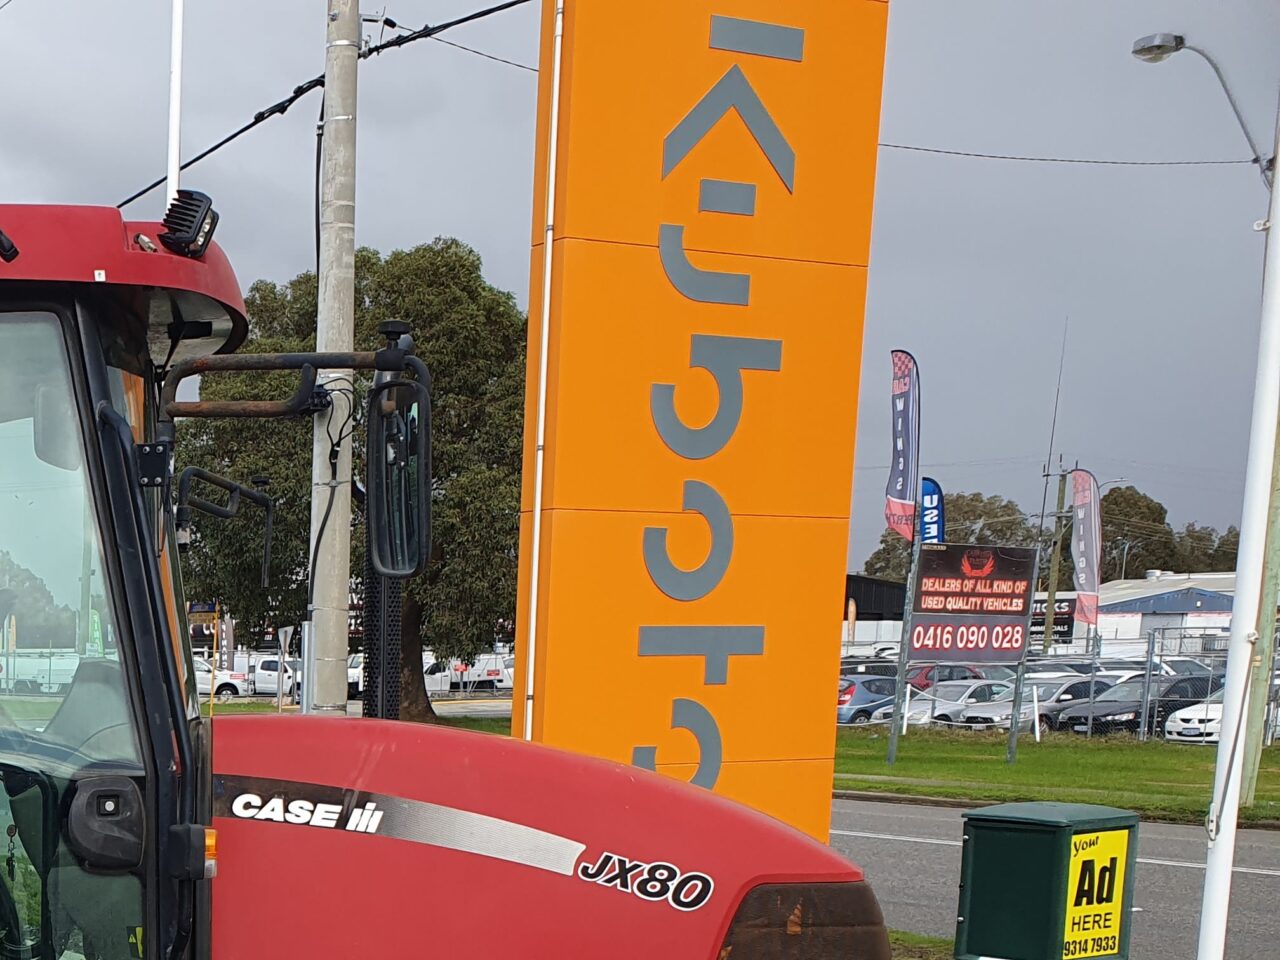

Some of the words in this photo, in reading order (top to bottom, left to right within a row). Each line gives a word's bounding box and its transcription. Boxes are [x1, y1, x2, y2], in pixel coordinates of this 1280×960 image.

[921, 577, 962, 592] DEALERS
[963, 579, 976, 593] OF
[975, 579, 992, 593] ALL
[993, 580, 1013, 594] KIND
[1014, 581, 1028, 594] OF
[921, 596, 945, 609] USED
[946, 597, 982, 611] QUALITY
[983, 598, 1024, 611] VEHICLES
[913, 625, 953, 649] 0416
[956, 625, 988, 649] 090
[991, 625, 1023, 649] 028
[231, 793, 342, 828] CASE
[578, 851, 714, 911] JX80
[1073, 857, 1118, 907] Ad
[1071, 912, 1112, 932] HERE
[1064, 938, 1088, 957] 9314
[1090, 935, 1116, 953] 7933
